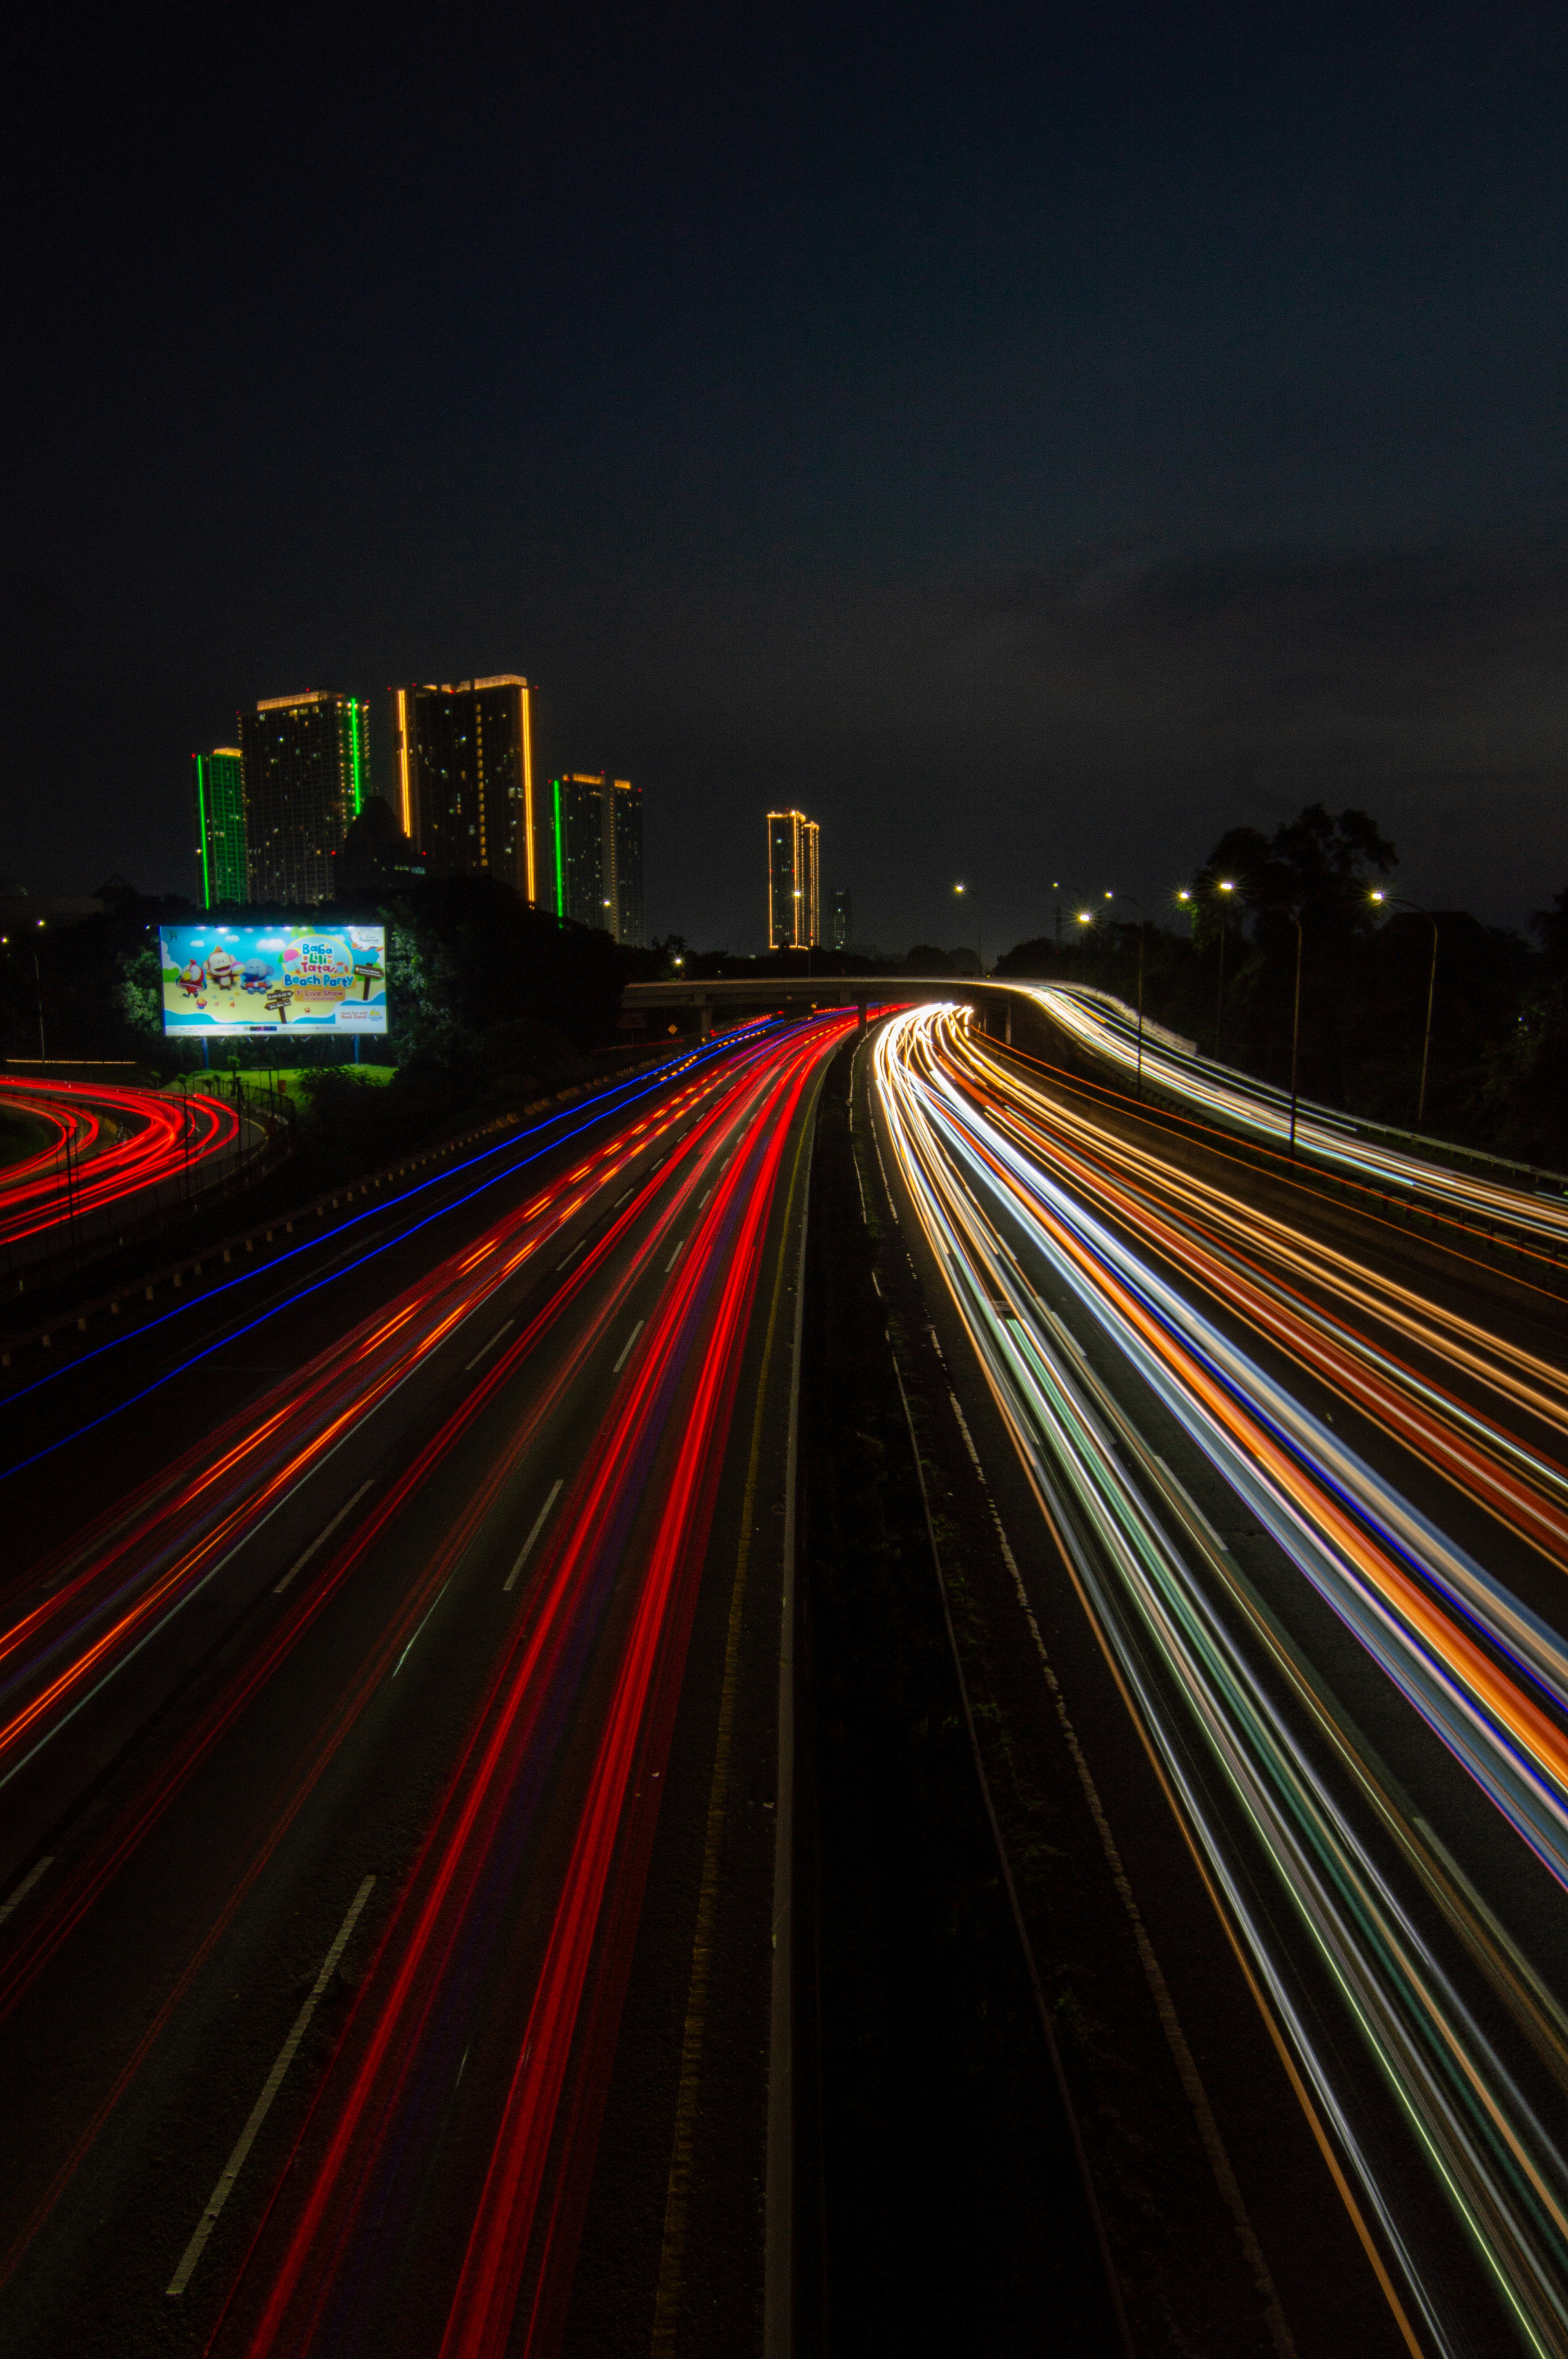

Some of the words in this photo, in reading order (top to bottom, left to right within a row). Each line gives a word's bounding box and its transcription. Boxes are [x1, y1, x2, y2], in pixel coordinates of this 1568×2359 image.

[309, 953, 326, 964] Lili
[300, 962, 336, 973] Tata
[285, 974, 321, 986] Beach
[323, 974, 354, 987] Party
